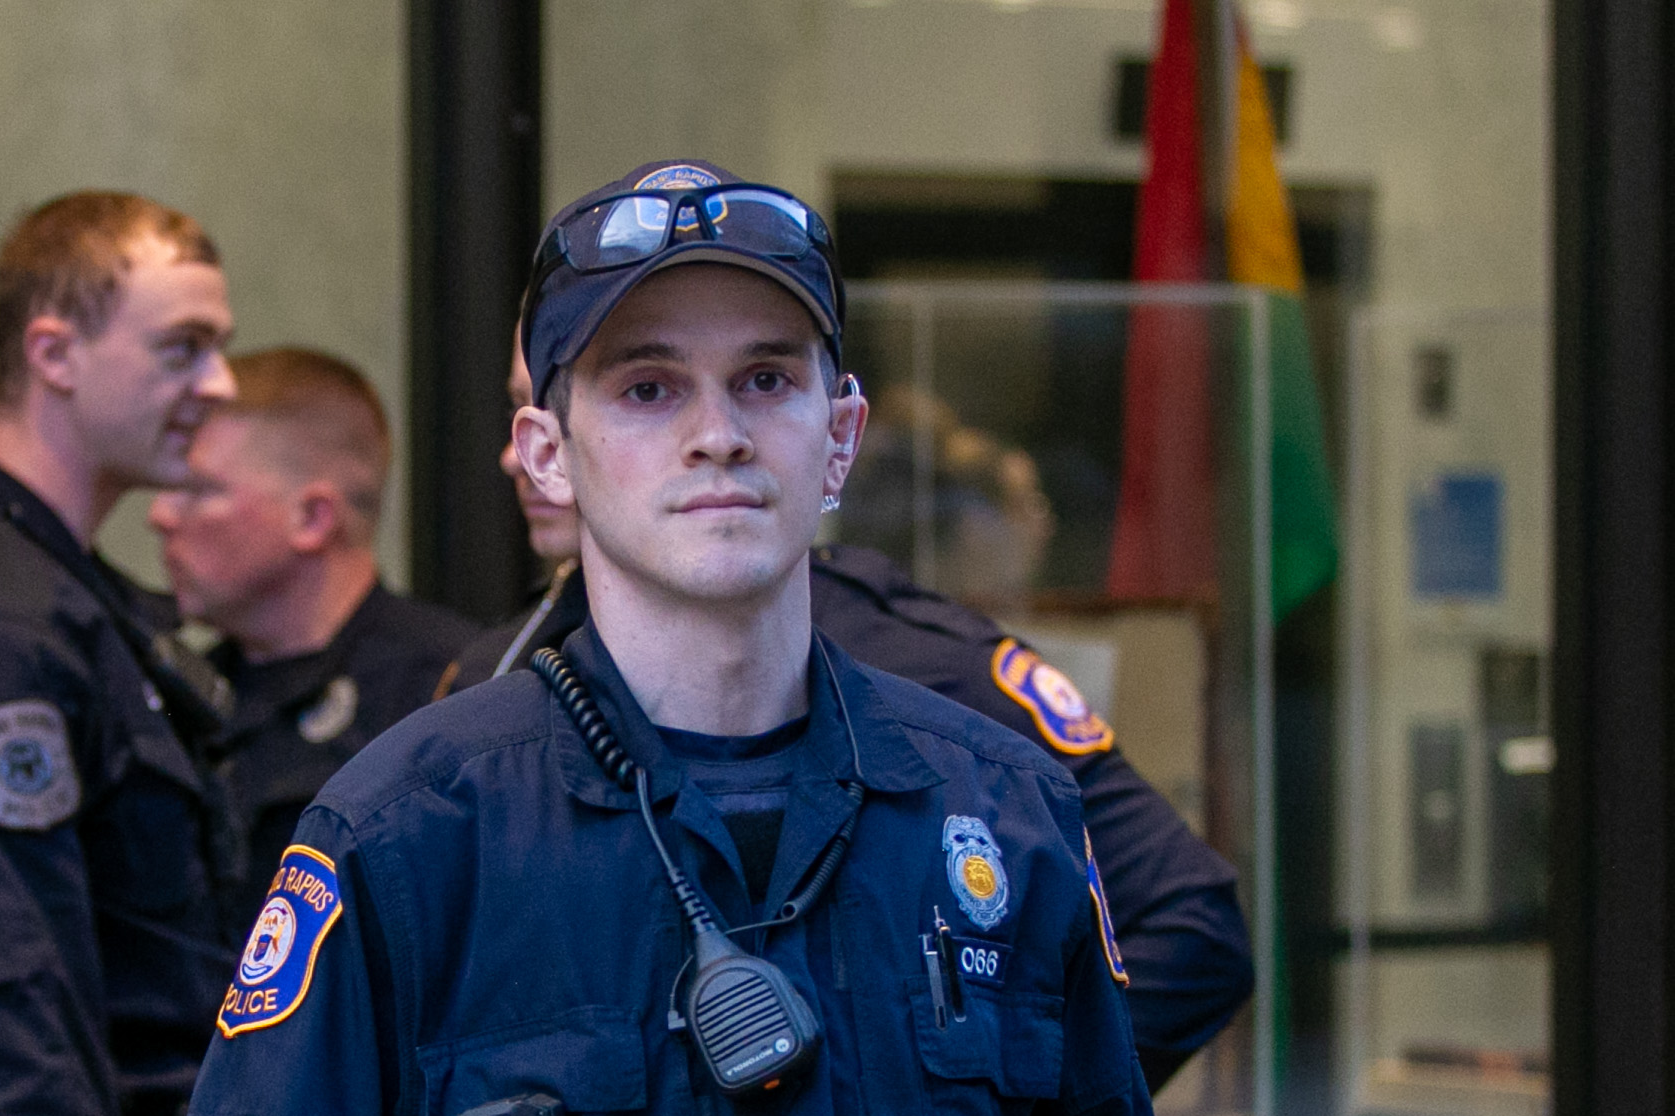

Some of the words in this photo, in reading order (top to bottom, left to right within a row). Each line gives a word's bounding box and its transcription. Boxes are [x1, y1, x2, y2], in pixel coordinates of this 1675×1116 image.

[284, 866, 334, 912] RAPIDS
[961, 947, 999, 976] 066
[223, 984, 279, 1016] OLICE
[726, 1047, 774, 1077] MOTOROLA
